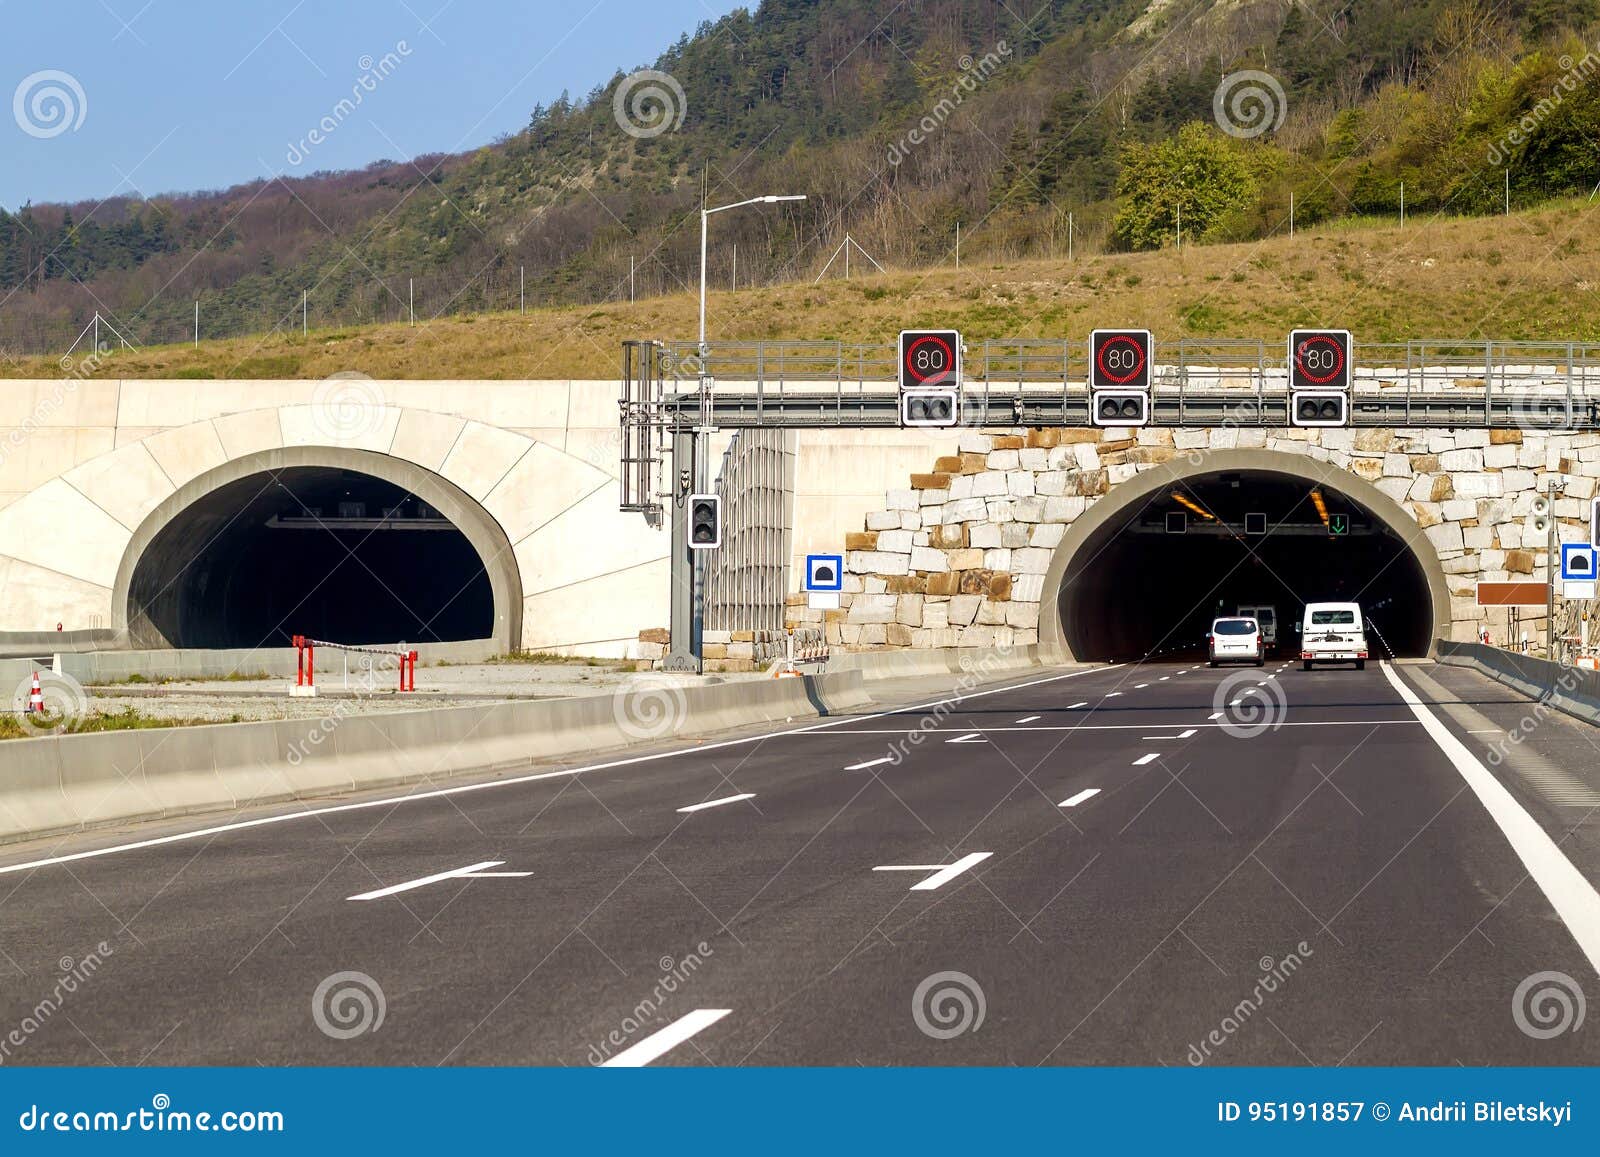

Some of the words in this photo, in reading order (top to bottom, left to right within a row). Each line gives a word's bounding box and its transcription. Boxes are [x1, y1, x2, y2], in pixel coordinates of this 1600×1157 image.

[917, 350, 943, 369] 80
[1108, 350, 1135, 369] 80
[1308, 350, 1334, 369] 80
